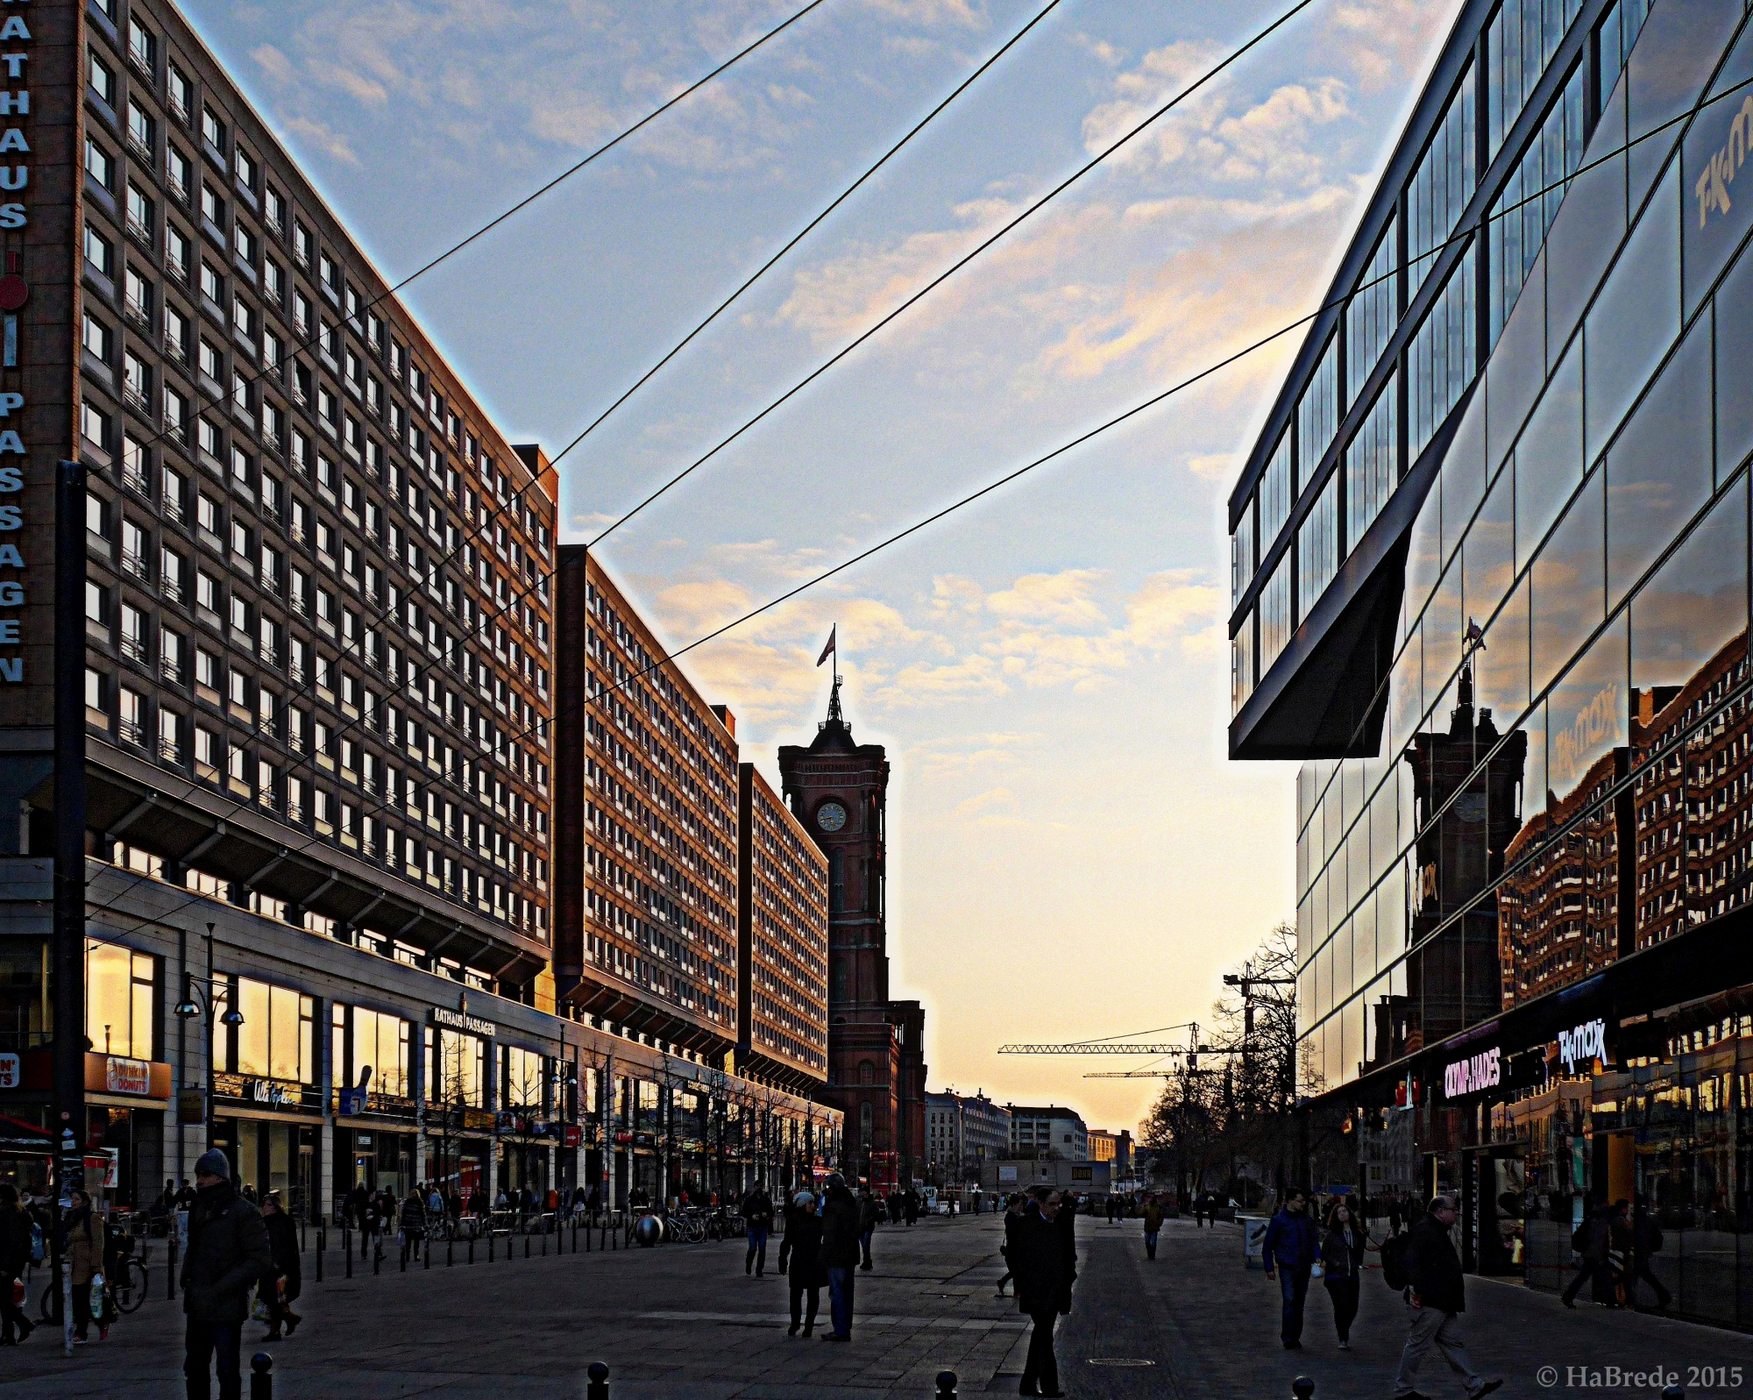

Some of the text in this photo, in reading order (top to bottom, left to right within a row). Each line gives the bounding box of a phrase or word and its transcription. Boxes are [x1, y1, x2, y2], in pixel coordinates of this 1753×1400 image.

[0, 0, 31, 229] ATHAUS
[434, 1007, 496, 1037] RATHAUS PASSAGEN
